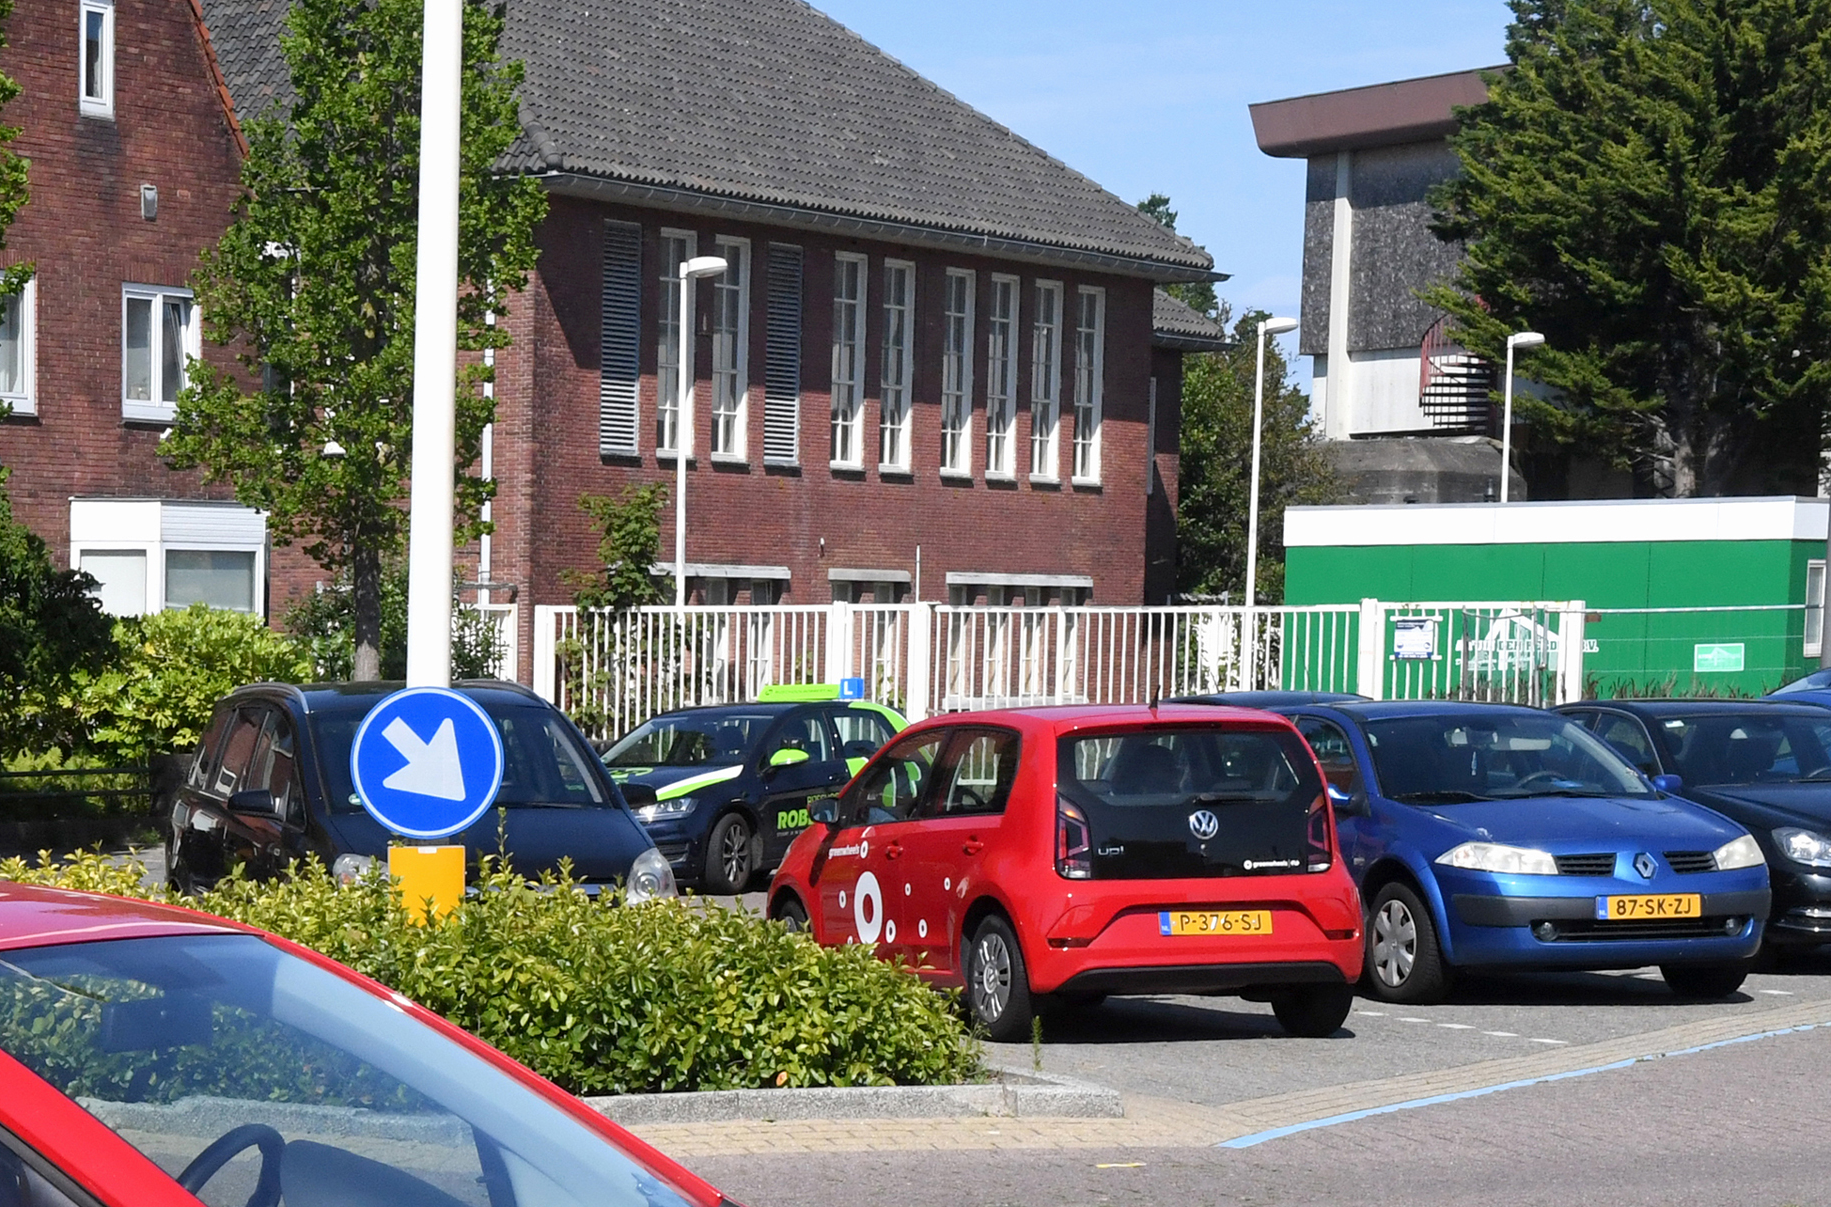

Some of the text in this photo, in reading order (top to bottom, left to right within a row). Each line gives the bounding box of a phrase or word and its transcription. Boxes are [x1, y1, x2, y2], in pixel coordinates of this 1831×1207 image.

[843, 681, 853, 695] L
[1616, 898, 1692, 916] 87-SK-ZJ
[1180, 913, 1262, 931] P-376-SJ
